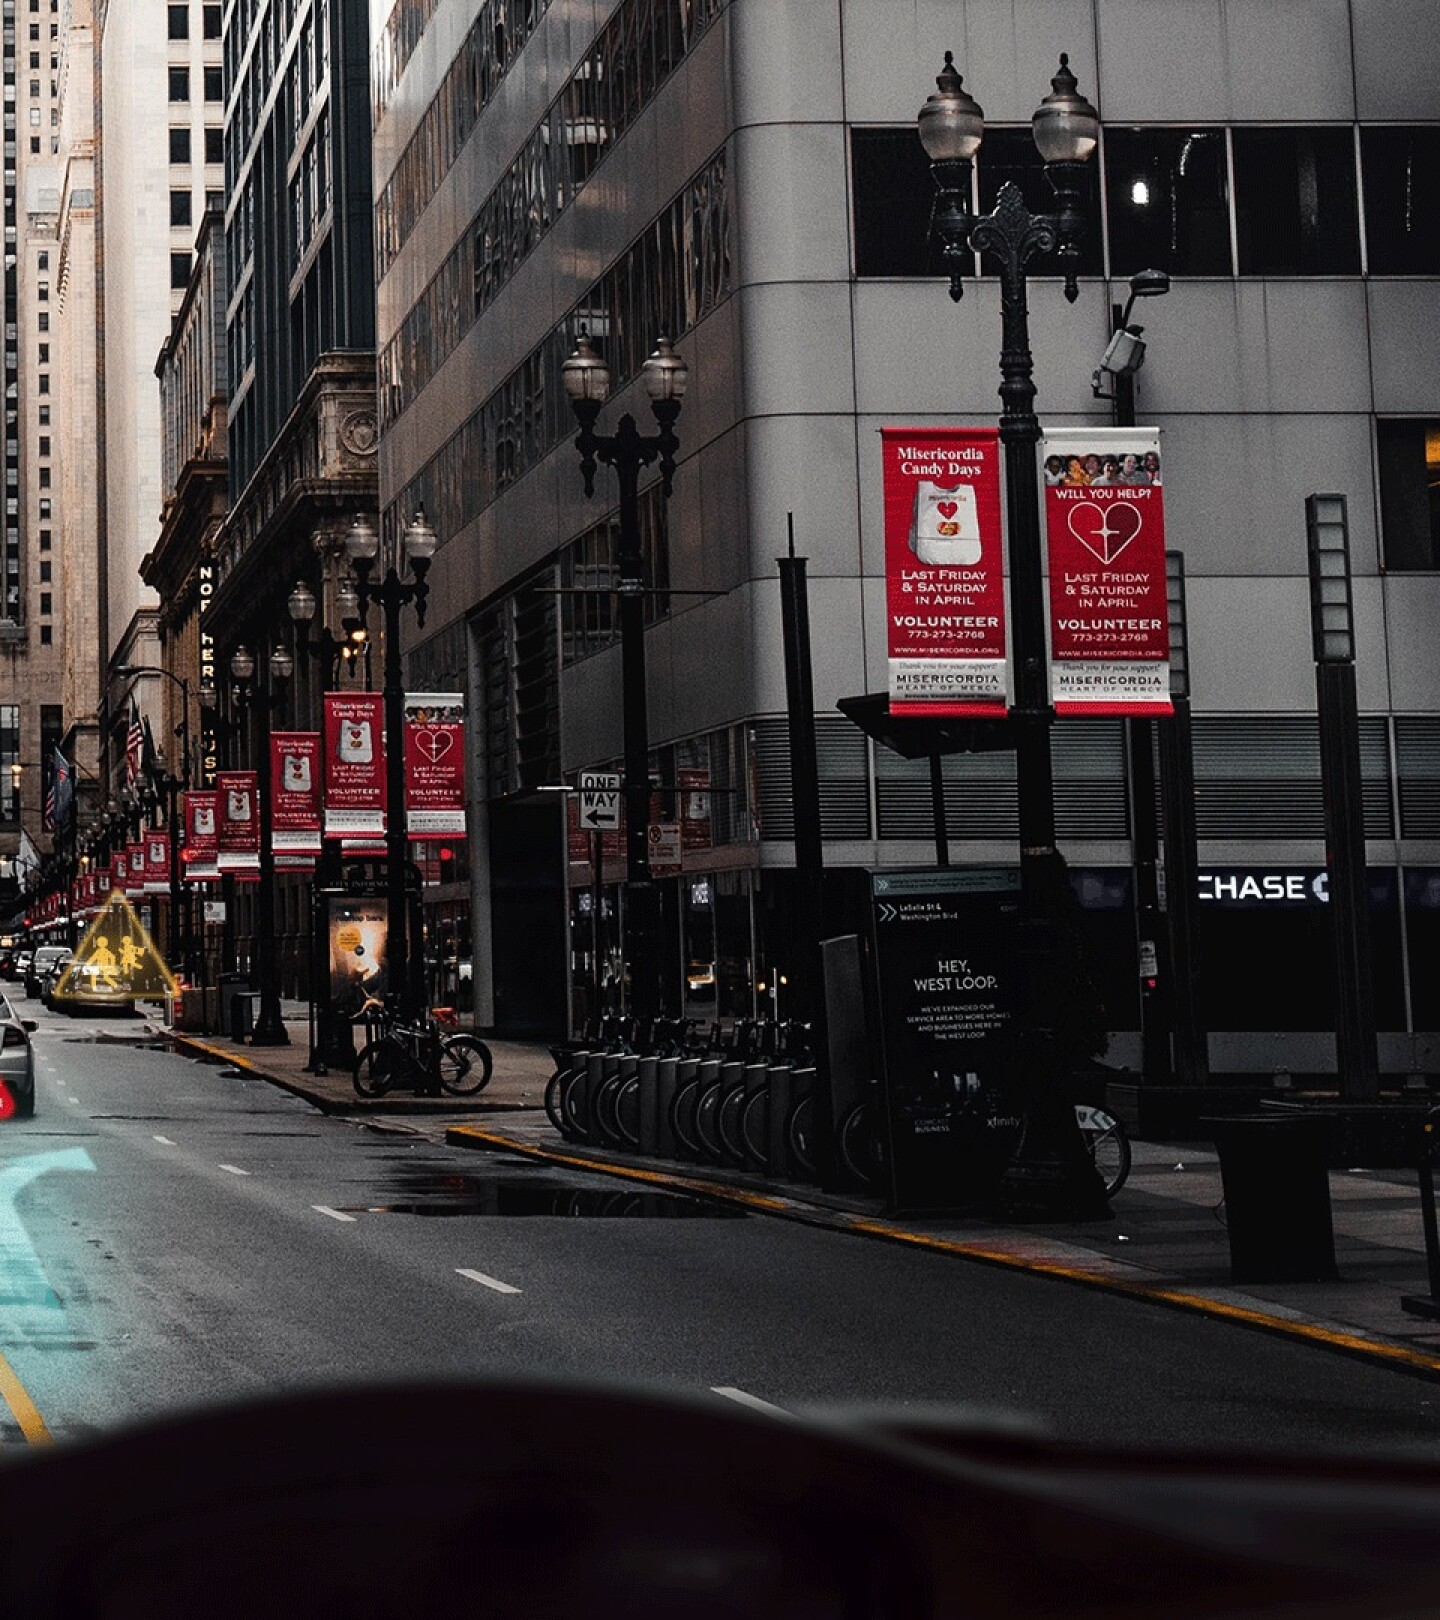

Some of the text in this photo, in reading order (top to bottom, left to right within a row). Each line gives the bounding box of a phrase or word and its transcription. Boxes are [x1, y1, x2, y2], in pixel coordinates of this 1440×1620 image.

[898, 447, 984, 460] Misericordia
[901, 462, 982, 478] Candy Days
[1056, 488, 1152, 499] WILL YOU HELP?
[901, 570, 987, 580] LAST FRIDAY
[1064, 572, 1150, 583] LAST FRIDAY
[902, 582, 987, 592] & SATURDAY
[1065, 585, 1150, 595] & SATURDAY
[915, 594, 975, 605] IN APRIL
[1080, 598, 1138, 608] IN APRIL
[894, 616, 999, 627] VOLUNTEER
[1058, 619, 1162, 630] VOLUNTEER
[908, 630, 985, 639] 773-273-2768
[1071, 633, 1149, 642] 773-273-2768
[897, 675, 999, 683] MISERICORDIA
[1060, 676, 1162, 685] MISERICORDIA
[584, 777, 616, 788] ONE
[584, 794, 616, 807] WAY
[938, 960, 971, 974] HEY,
[914, 976, 998, 991] WEST LOOP.
[987, 1116, 1021, 1128] xfinity
